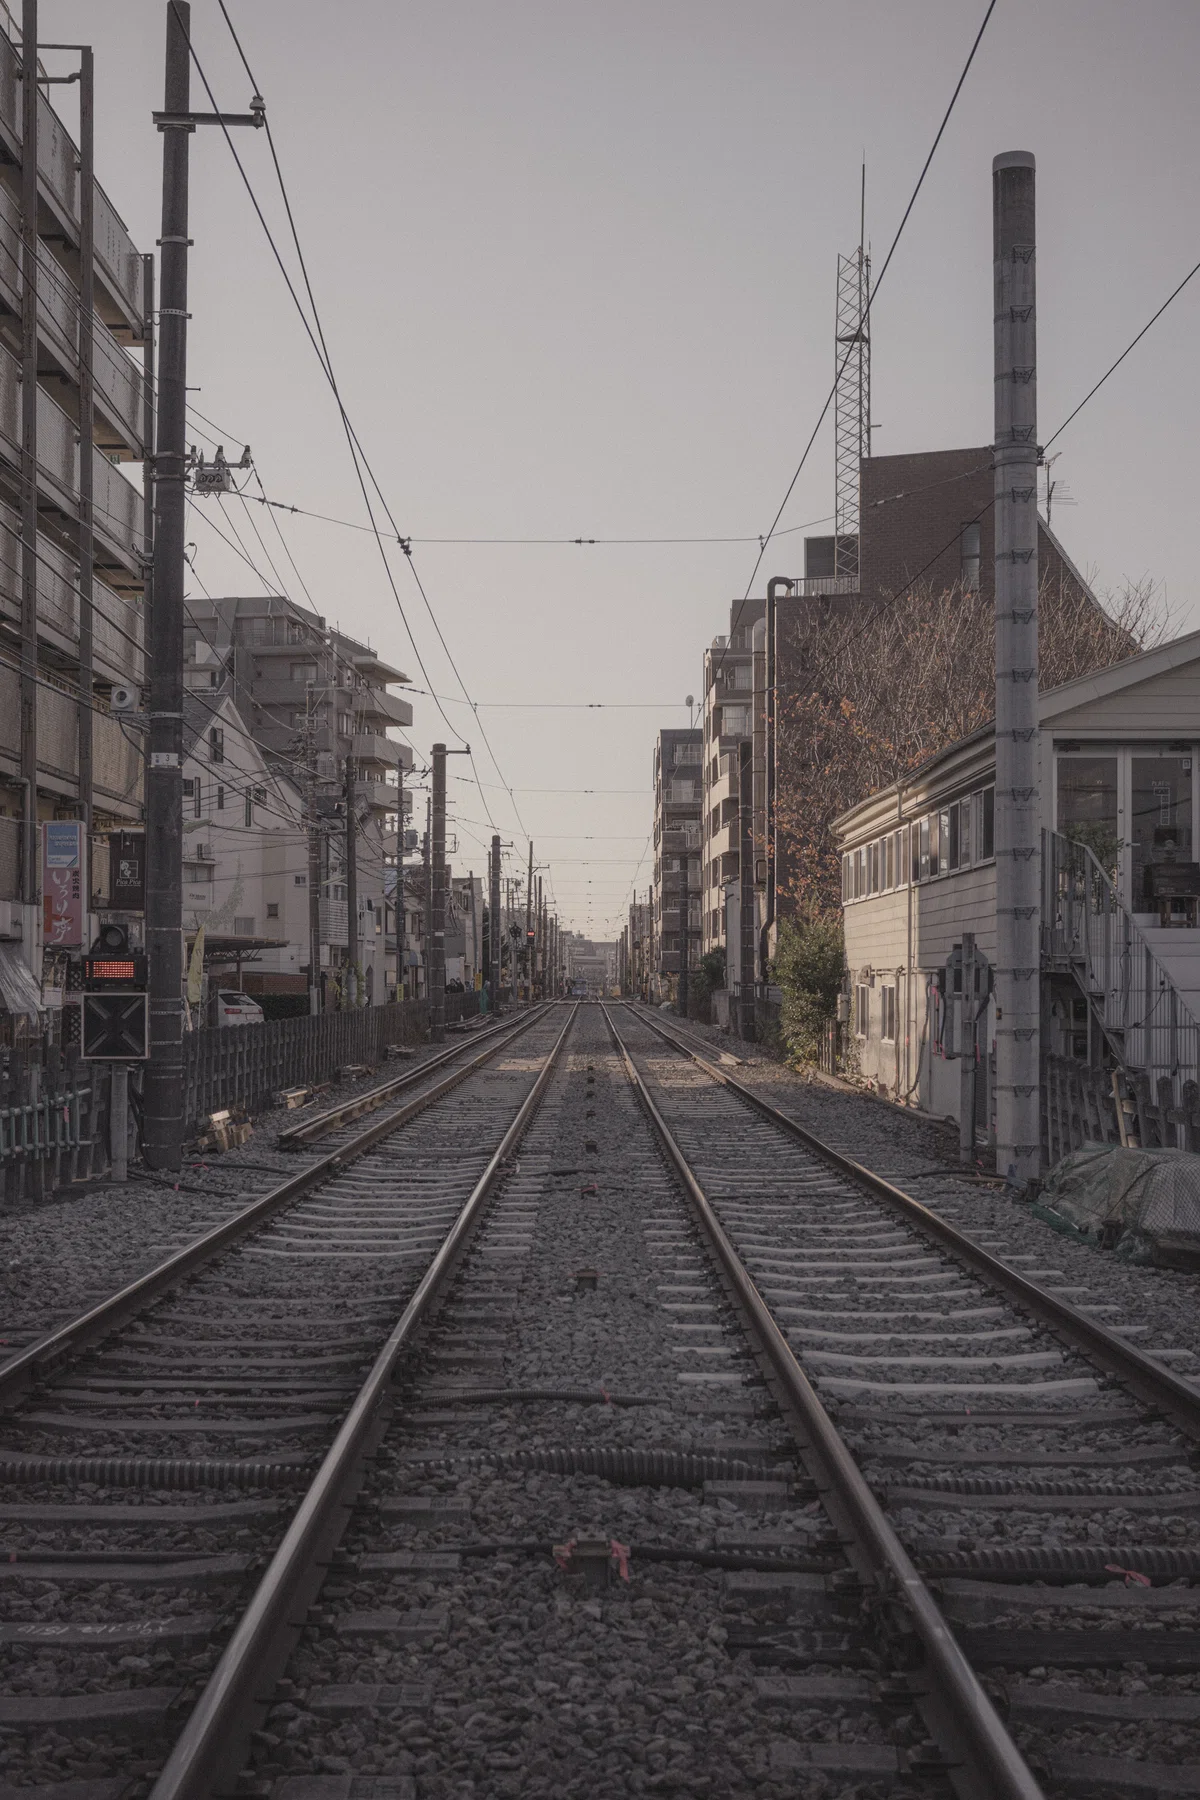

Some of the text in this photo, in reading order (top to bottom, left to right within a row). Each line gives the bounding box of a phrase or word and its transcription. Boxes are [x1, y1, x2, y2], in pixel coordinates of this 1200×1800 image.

[49, 870, 73, 945] いろり亭
[71, 870, 80, 900] 炭火焼肉
